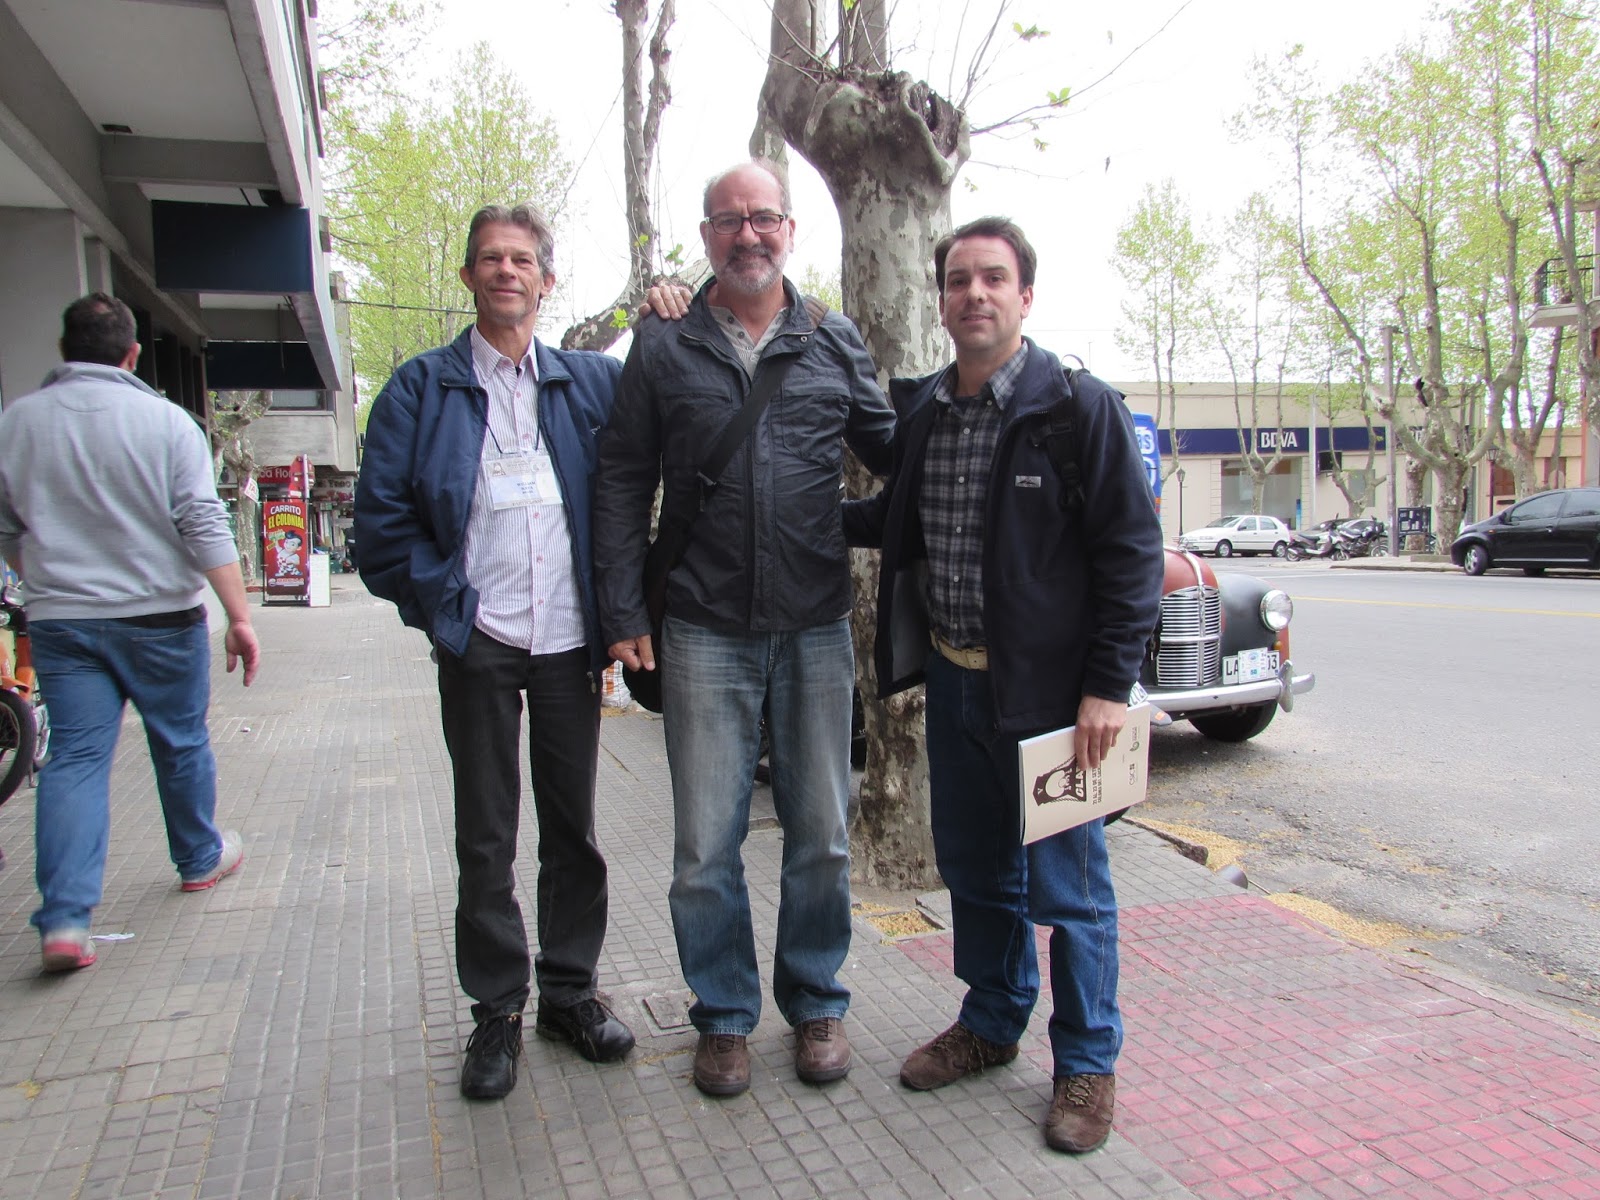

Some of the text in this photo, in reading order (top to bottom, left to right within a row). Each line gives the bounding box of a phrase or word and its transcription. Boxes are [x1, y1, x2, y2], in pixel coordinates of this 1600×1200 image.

[270, 504, 302, 515] CARRITO
[268, 513, 305, 530] EL COLONIAL
[1075, 767, 1084, 798] CLA
